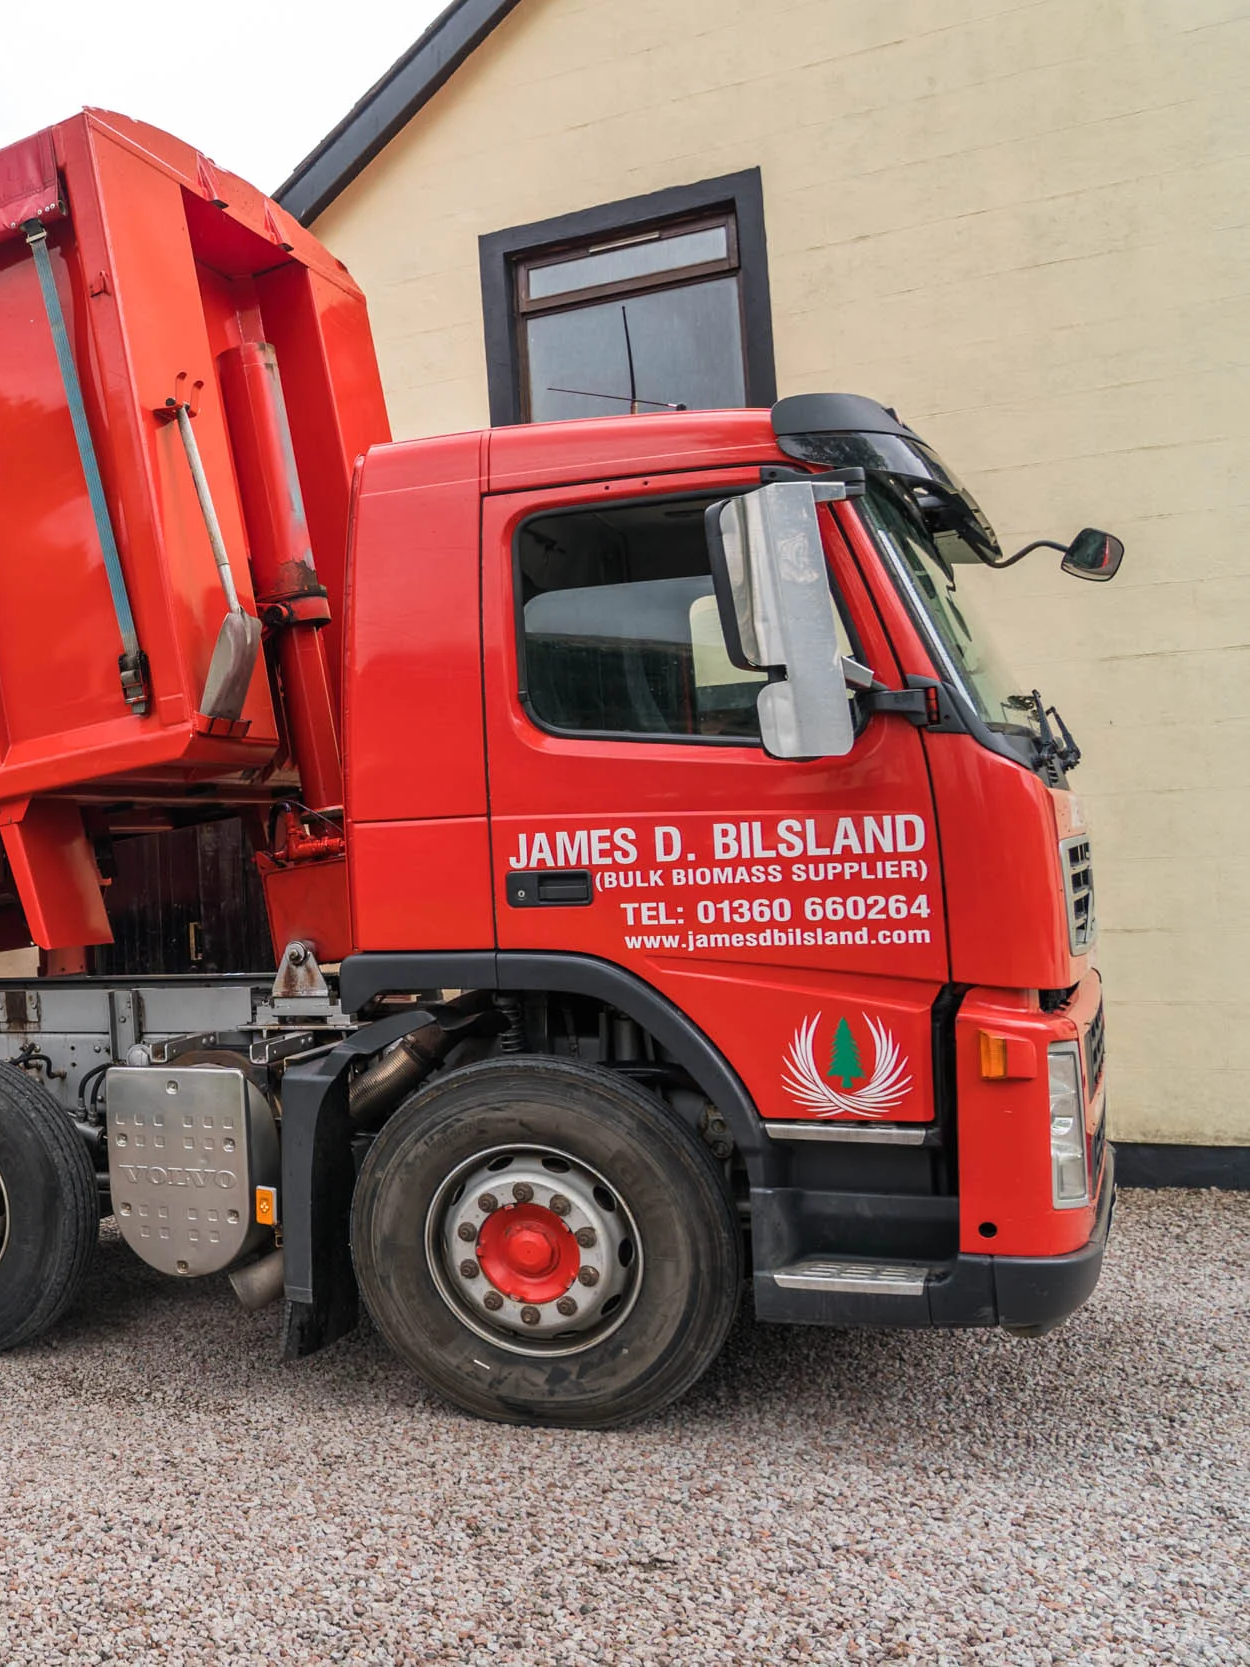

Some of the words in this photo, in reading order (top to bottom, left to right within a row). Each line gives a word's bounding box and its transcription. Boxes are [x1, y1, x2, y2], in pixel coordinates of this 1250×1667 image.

[509, 827, 638, 870] JAMES
[654, 825, 696, 863] D.
[713, 814, 926, 860] BILSLAND
[595, 868, 665, 893] (BULK
[672, 865, 783, 886] BIOMASS
[791, 859, 928, 882] SUPPLIER)
[620, 902, 685, 926] TEL:
[696, 897, 792, 924] 01360
[804, 895, 931, 921] 660264
[624, 926, 931, 952] www.jamesdbilsland.com
[117, 1164, 237, 1190] VOLVO
